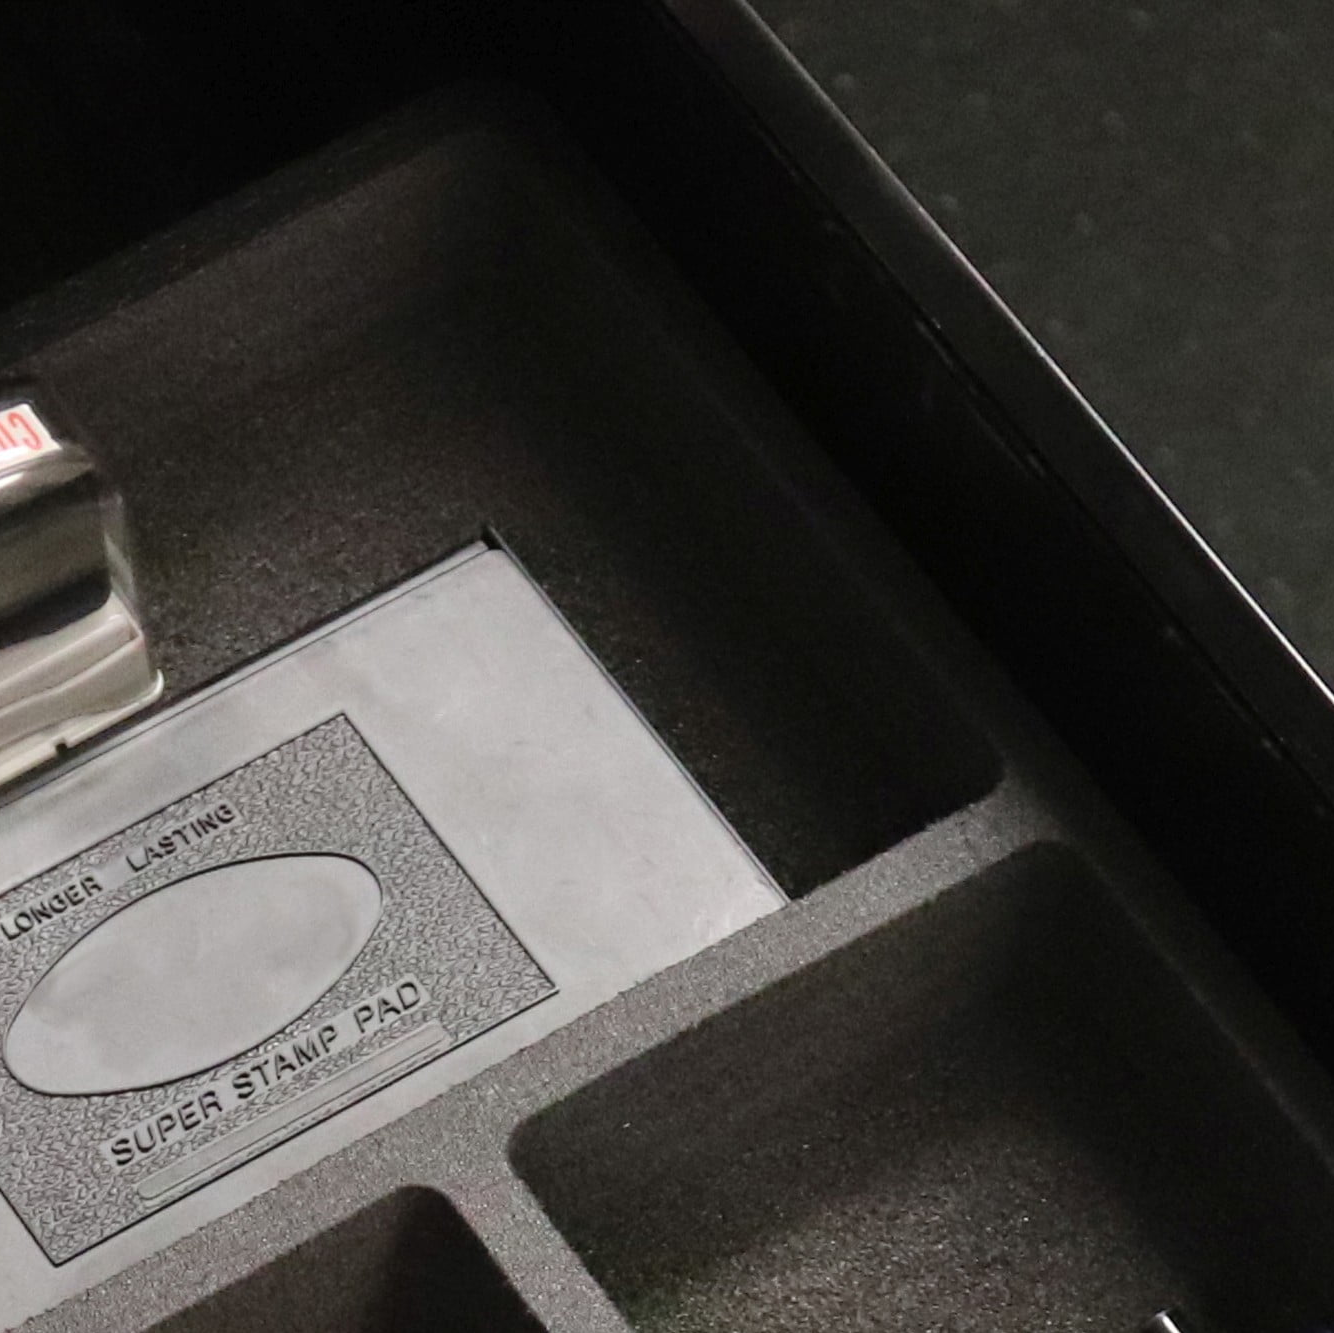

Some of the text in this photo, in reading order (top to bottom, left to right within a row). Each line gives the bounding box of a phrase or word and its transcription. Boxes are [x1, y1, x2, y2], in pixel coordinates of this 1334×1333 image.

[125, 803, 237, 875] LASTING
[109, 980, 423, 1168] SUPER STAMP PAD
